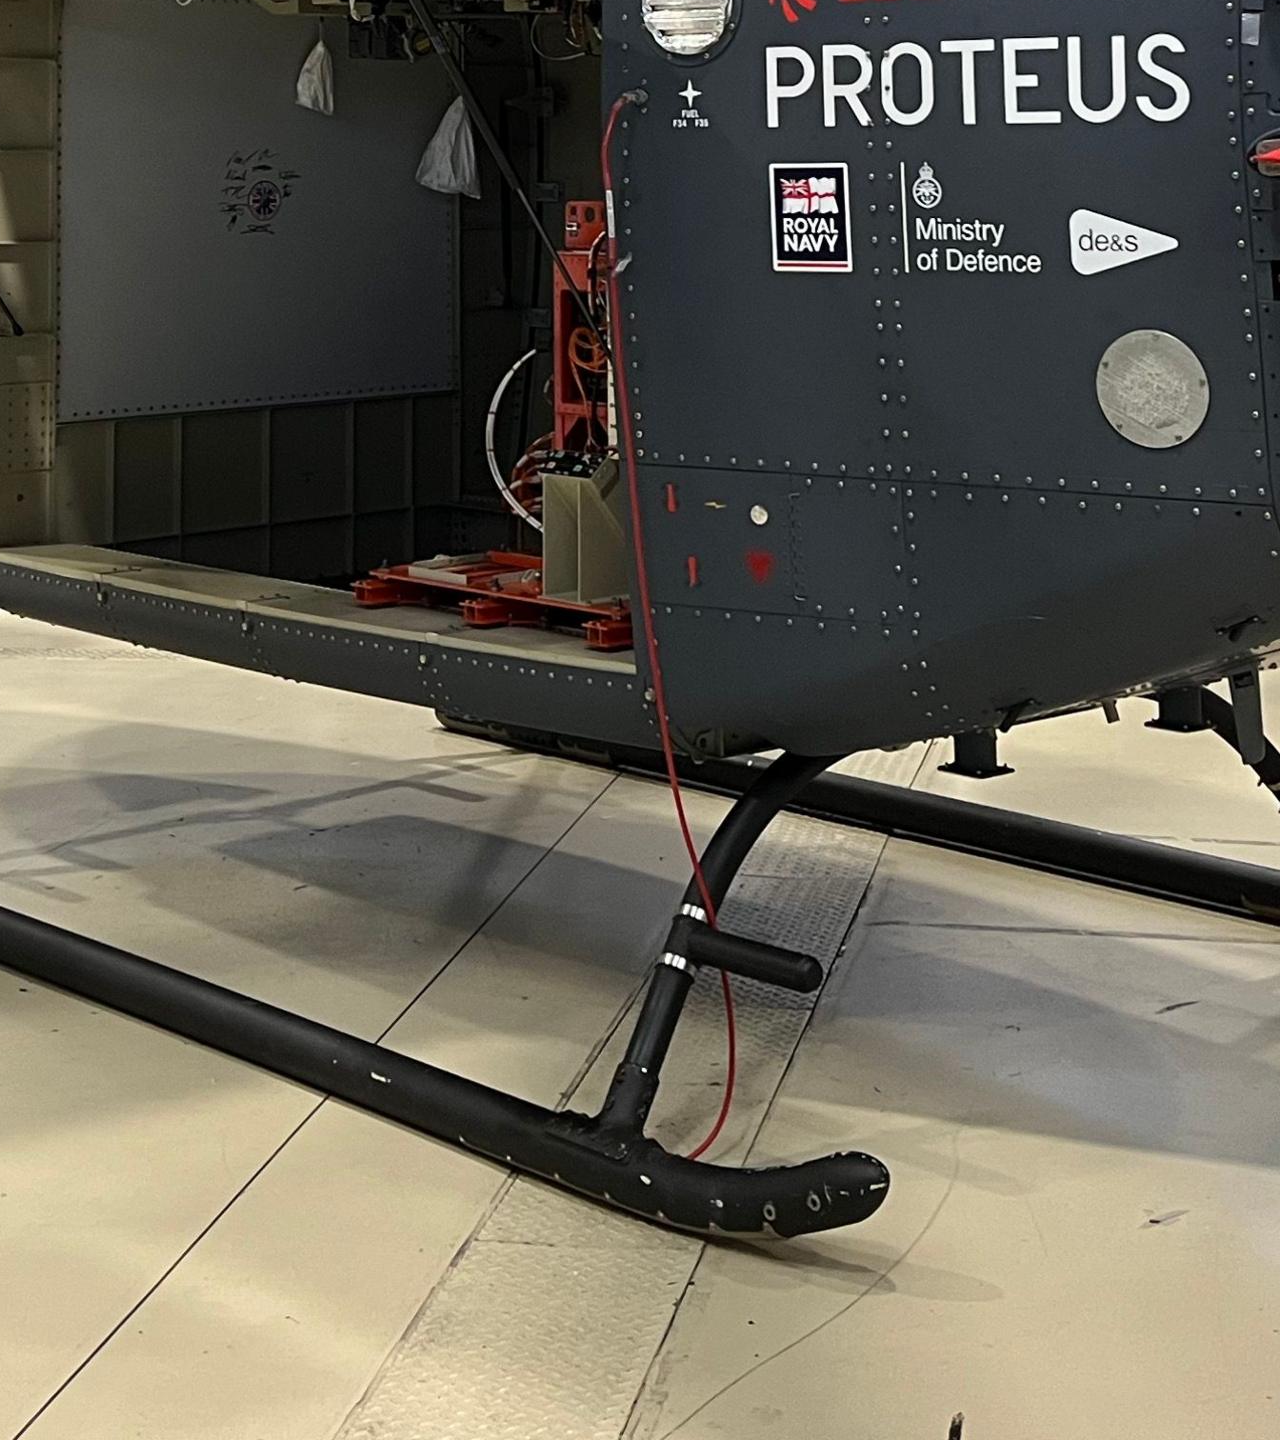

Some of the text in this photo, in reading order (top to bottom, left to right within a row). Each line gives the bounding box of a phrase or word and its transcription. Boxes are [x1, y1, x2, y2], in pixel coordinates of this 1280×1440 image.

[765, 33, 1191, 128] PROTEUS
[681, 109, 700, 118] FUEL
[782, 217, 839, 236] ROYAL
[915, 217, 1005, 247] Ministry
[783, 234, 839, 254] NAVY
[1078, 229, 1139, 254] de&s
[916, 247, 1042, 273] of Defence
